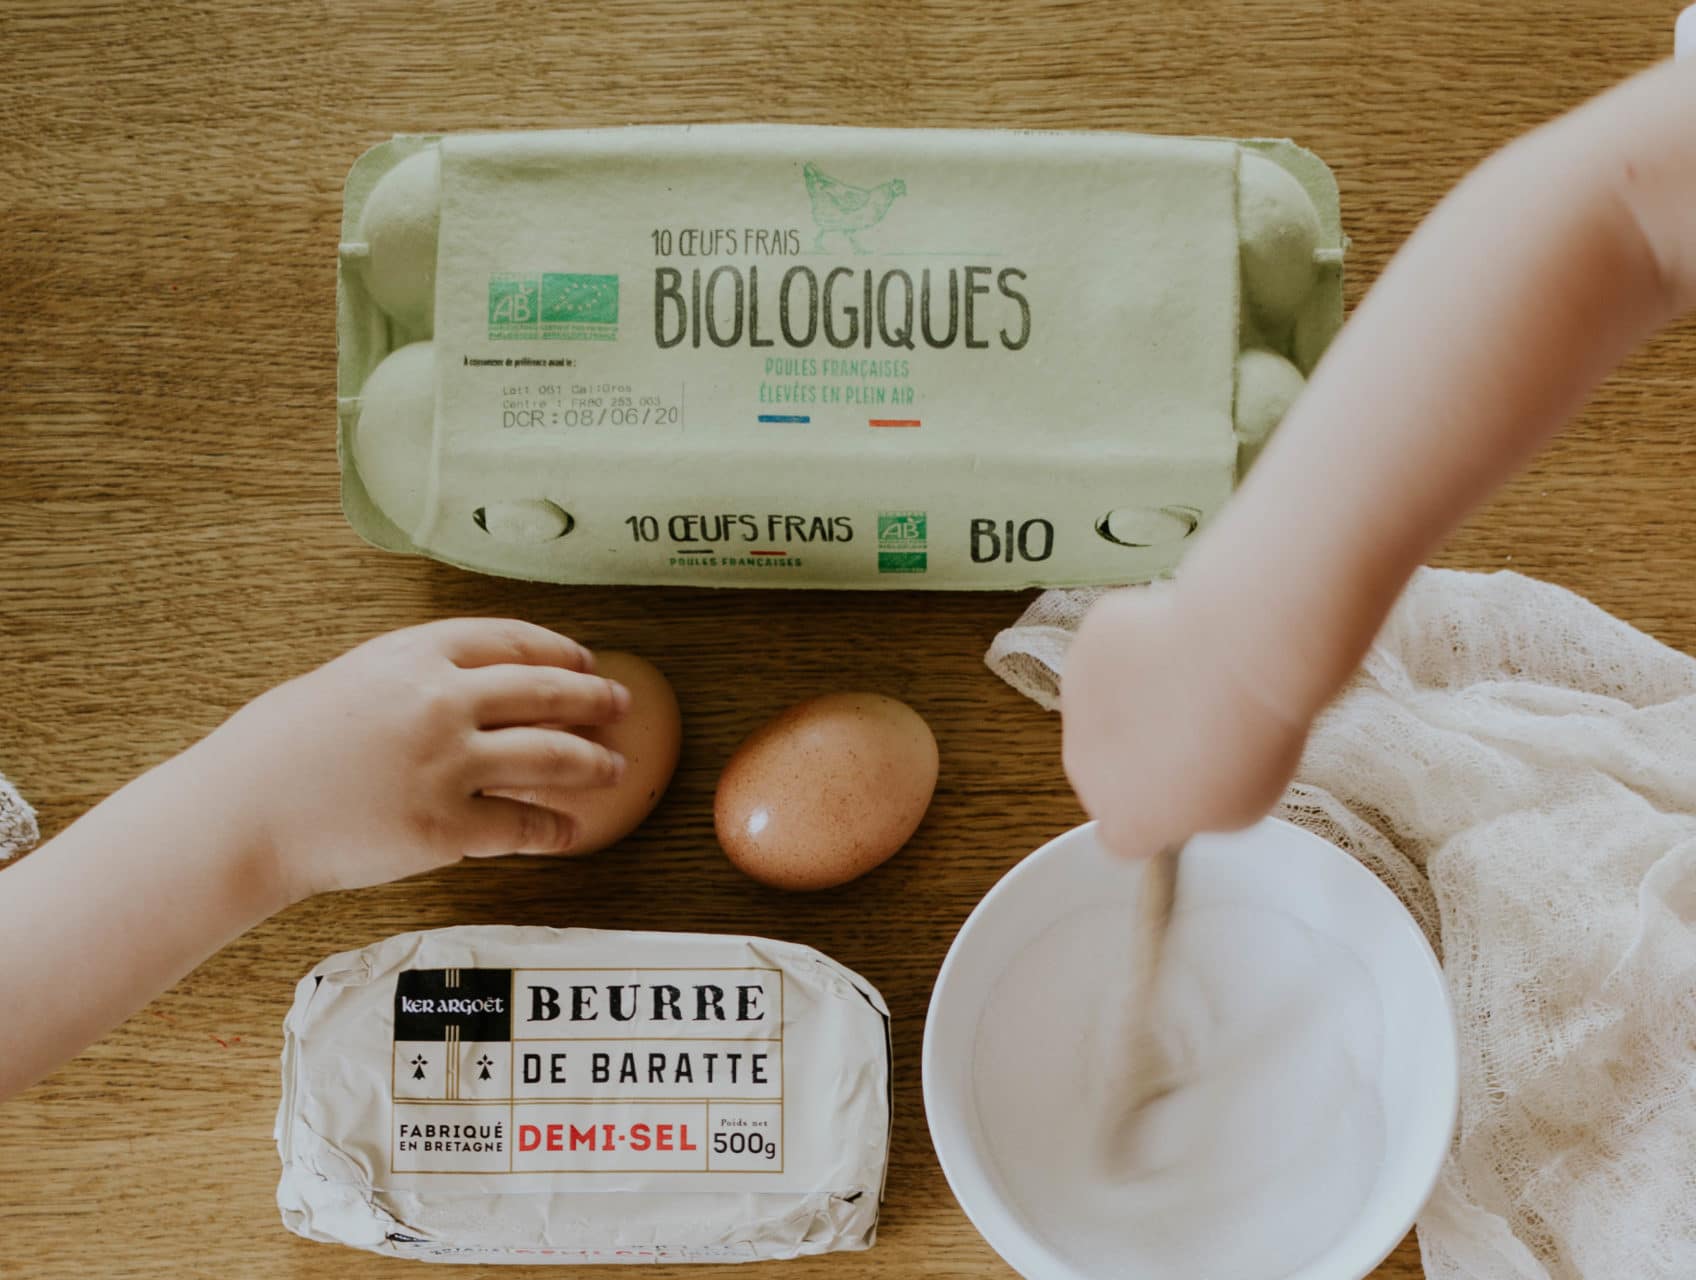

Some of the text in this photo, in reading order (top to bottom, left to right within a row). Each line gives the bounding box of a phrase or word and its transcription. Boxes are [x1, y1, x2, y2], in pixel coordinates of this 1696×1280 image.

[651, 229, 800, 256] 10 ŒUFS FRAIS
[493, 293, 531, 322] AB
[654, 265, 1031, 351] BIOLOGIQUES
[765, 357, 910, 381] POULES FRANÇAISES
[759, 381, 914, 405] ÉLEVÉES EN PLEIN AIR
[625, 514, 853, 543] 10 ŒUFS FRAIS
[880, 523, 920, 540] AB
[970, 518, 1054, 564] BIO
[669, 557, 717, 567] POULES
[527, 984, 765, 1022] BEURRE
[523, 1052, 768, 1084] DE BARATTE
[400, 1121, 503, 1139] FABRIQUÉ
[720, 1118, 747, 1127] Poids
[399, 1141, 503, 1152] EN BRETAGNE
[519, 1123, 697, 1152] DEMI-SEL
[713, 1132, 776, 1160] 500g
